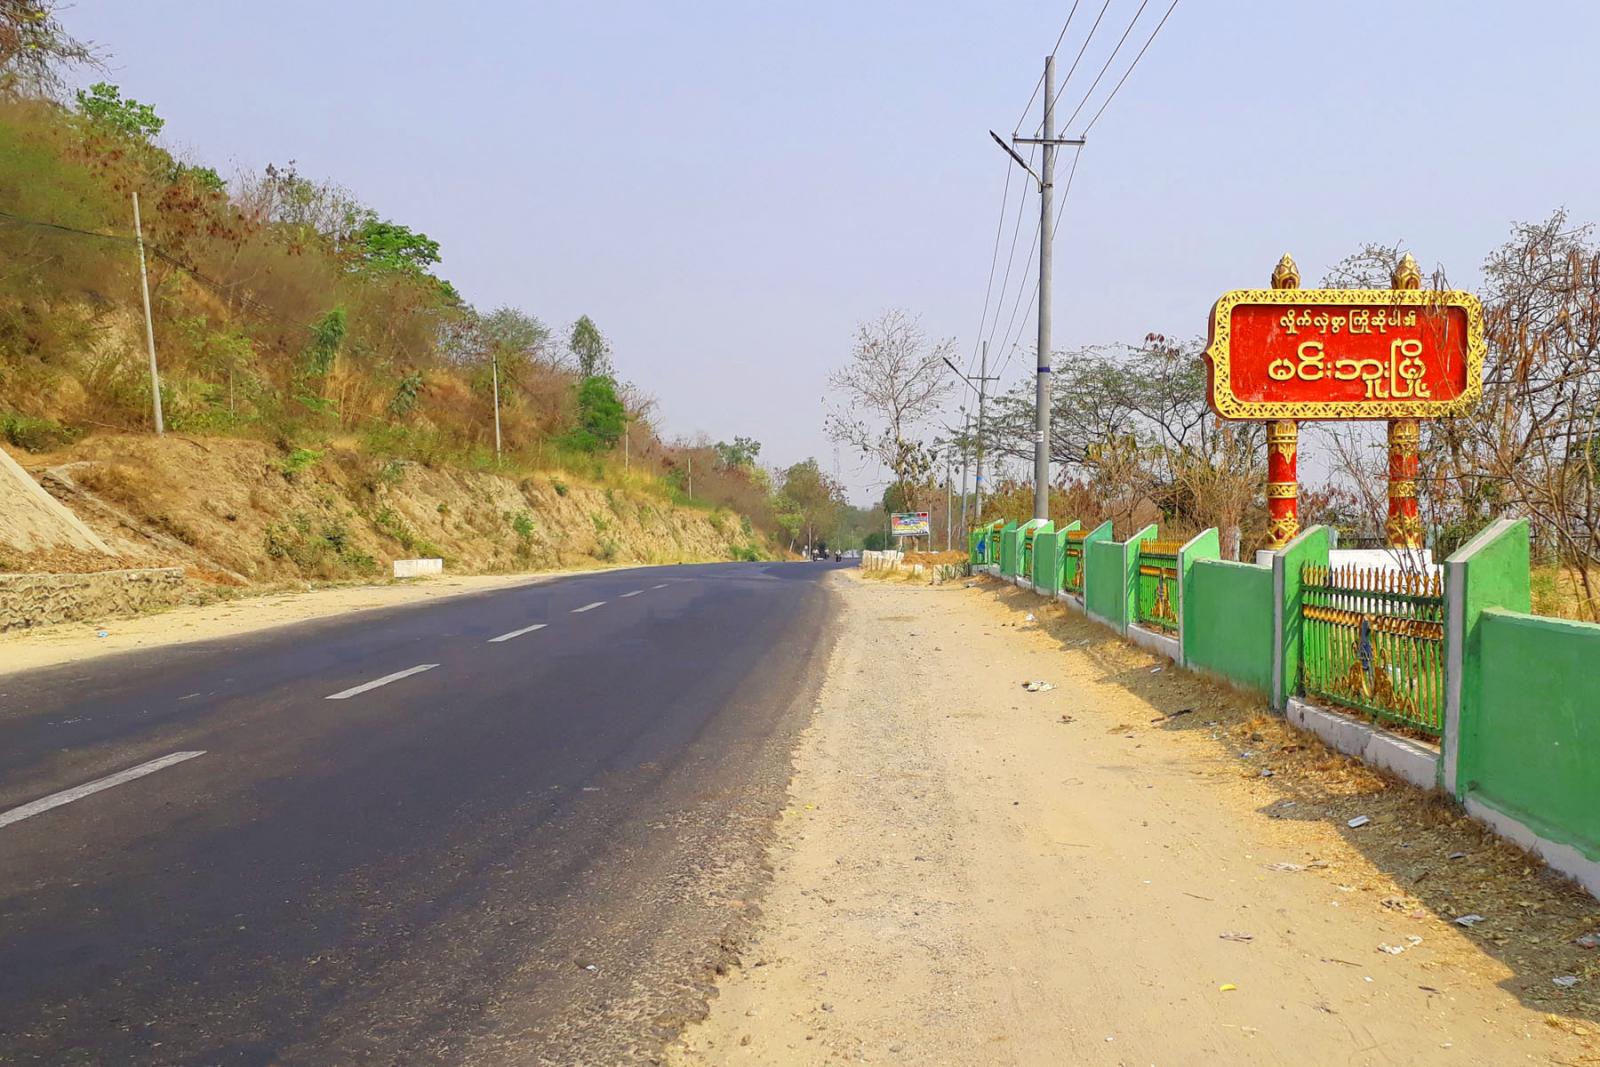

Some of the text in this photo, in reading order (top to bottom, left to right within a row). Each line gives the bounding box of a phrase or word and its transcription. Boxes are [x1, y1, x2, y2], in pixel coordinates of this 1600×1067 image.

[1268, 338, 1431, 398] မင်းဘူးမြို့
